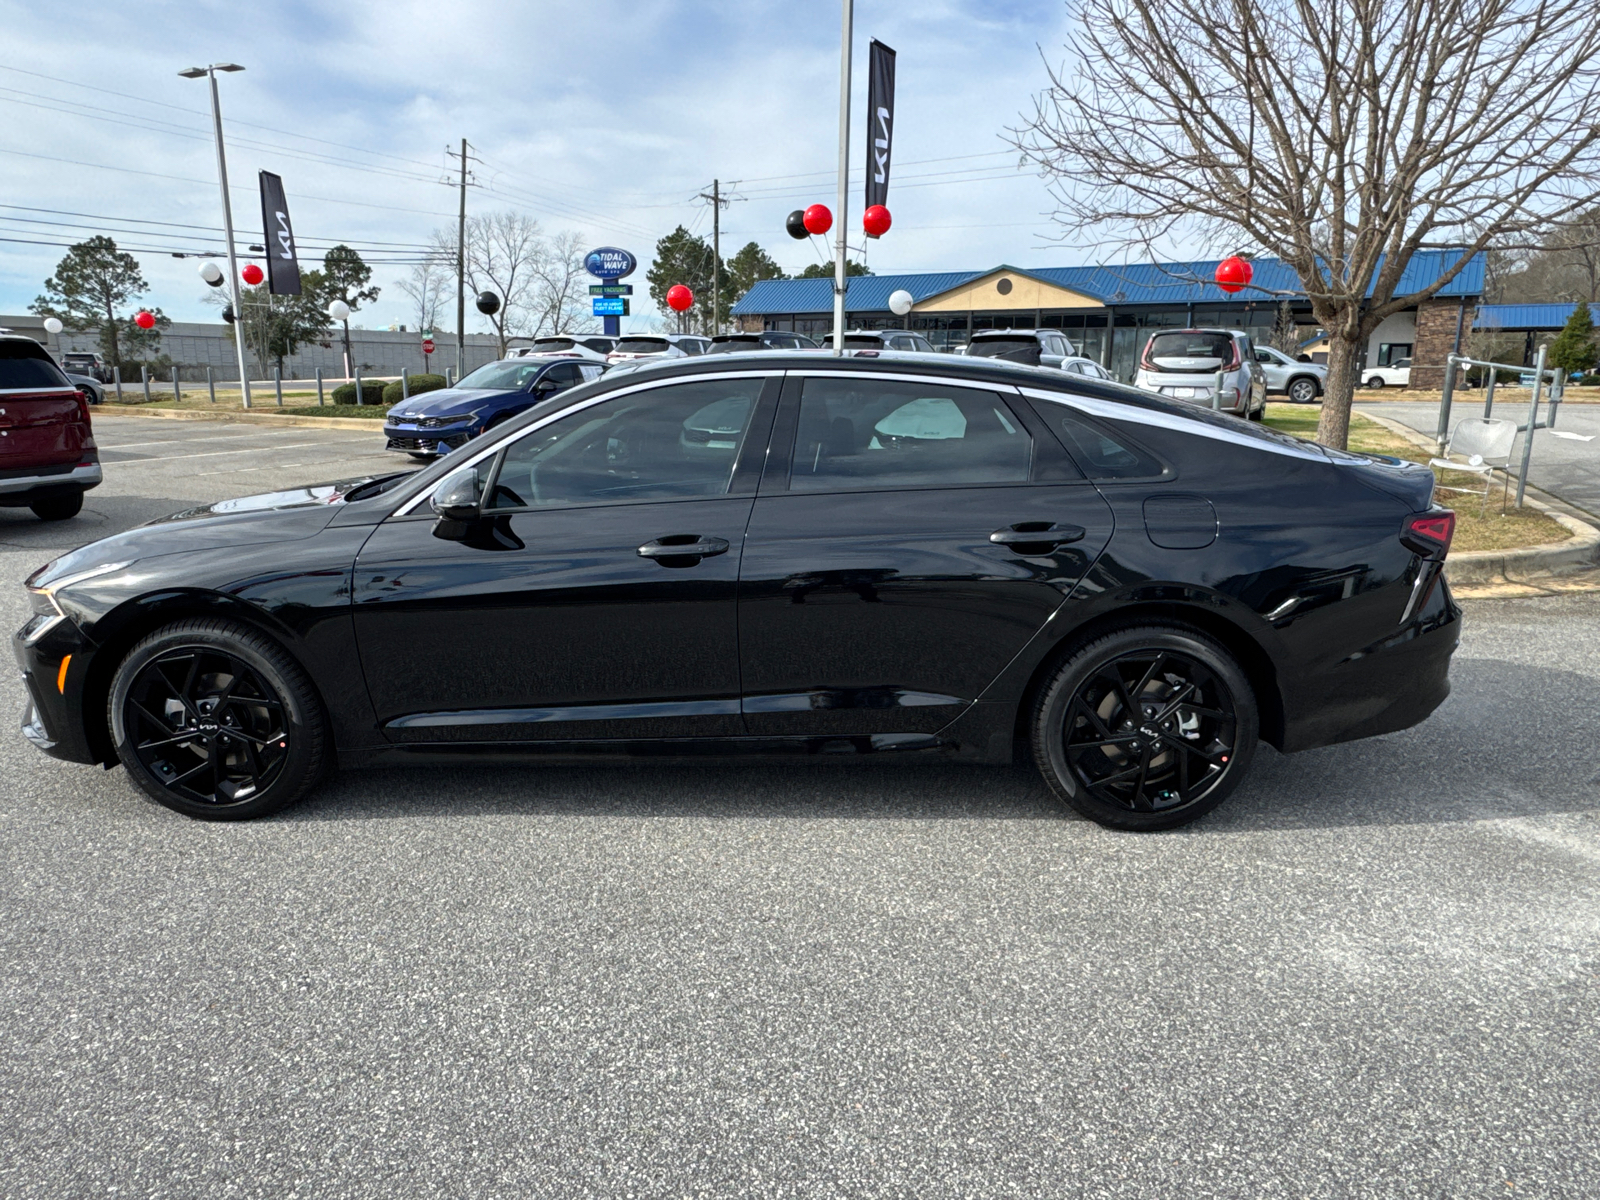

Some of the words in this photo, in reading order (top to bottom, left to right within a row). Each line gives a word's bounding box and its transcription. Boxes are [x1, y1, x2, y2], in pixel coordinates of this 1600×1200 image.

[874, 106, 890, 184] KIA
[275, 211, 293, 260] KIA
[600, 253, 622, 261] TIDAL
[603, 261, 627, 269] WAVE
